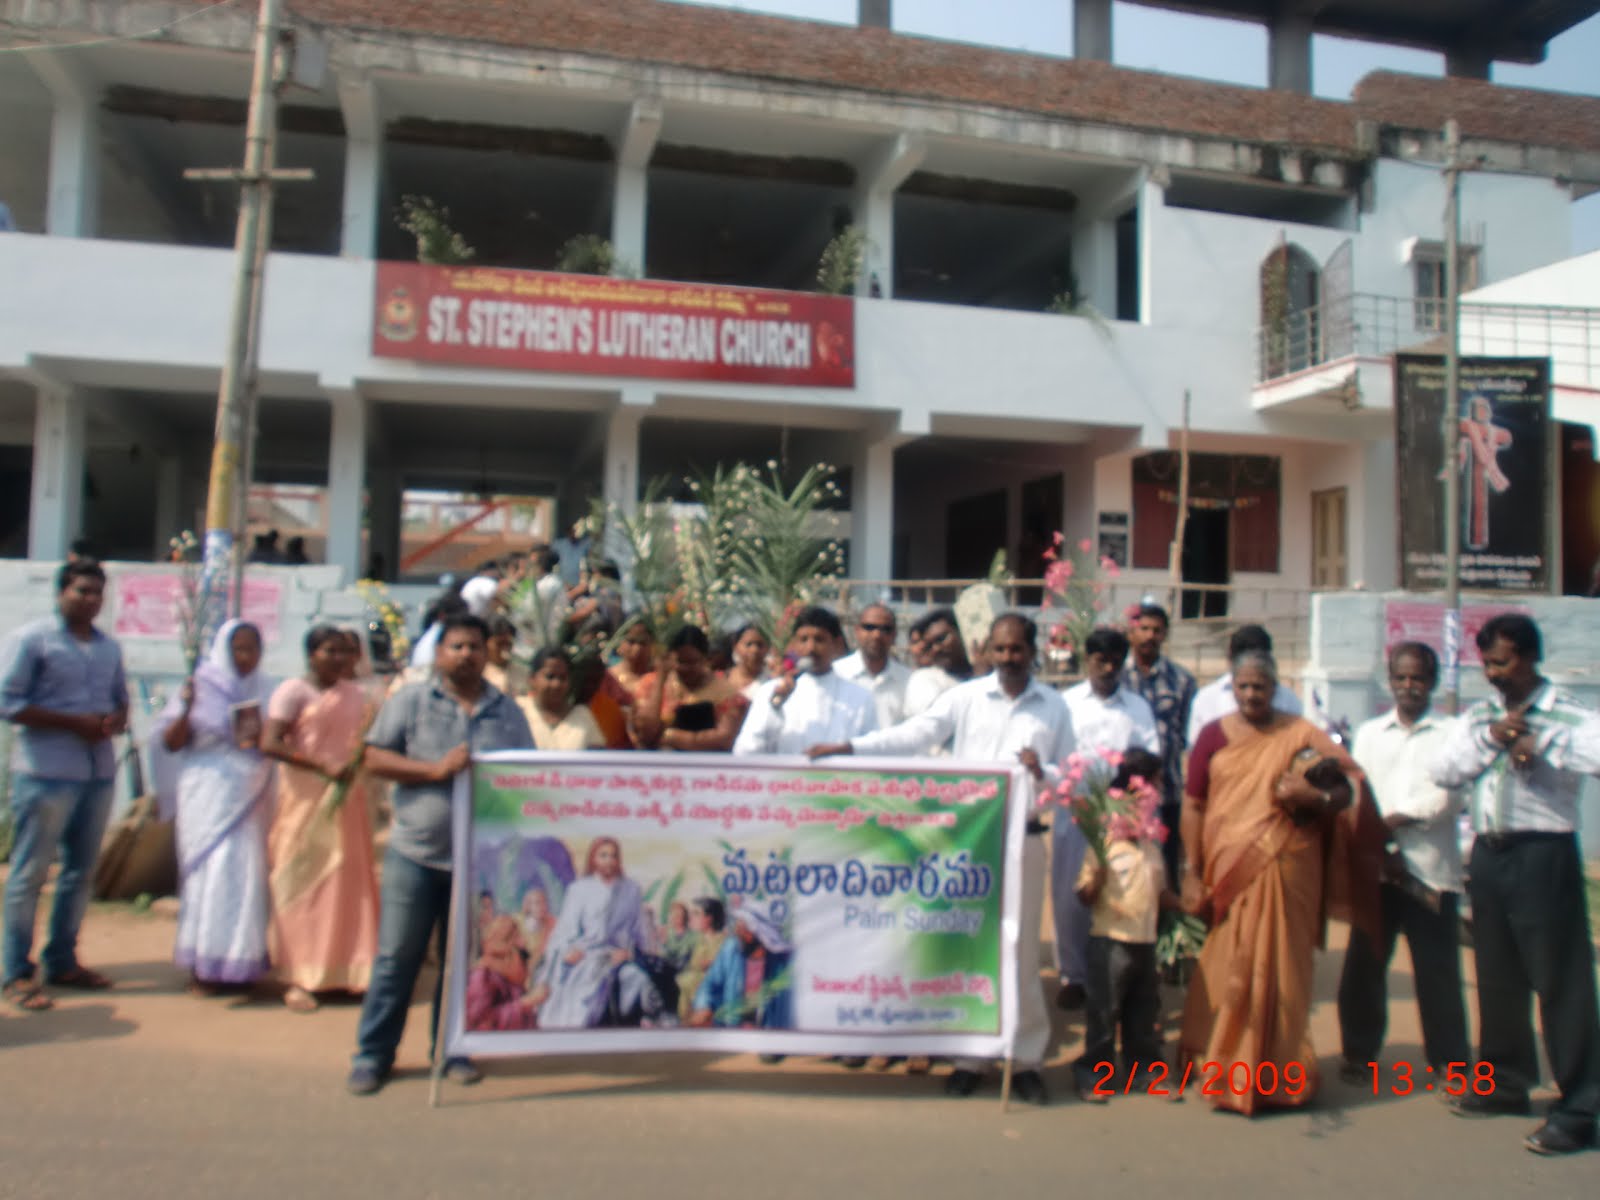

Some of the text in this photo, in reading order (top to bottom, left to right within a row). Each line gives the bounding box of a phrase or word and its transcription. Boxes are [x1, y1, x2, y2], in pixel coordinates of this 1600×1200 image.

[427, 295, 464, 346] ST.
[597, 311, 716, 363] LUTHERAN
[720, 318, 812, 370] CHURCH
[843, 905, 984, 938] Palm Sunday
